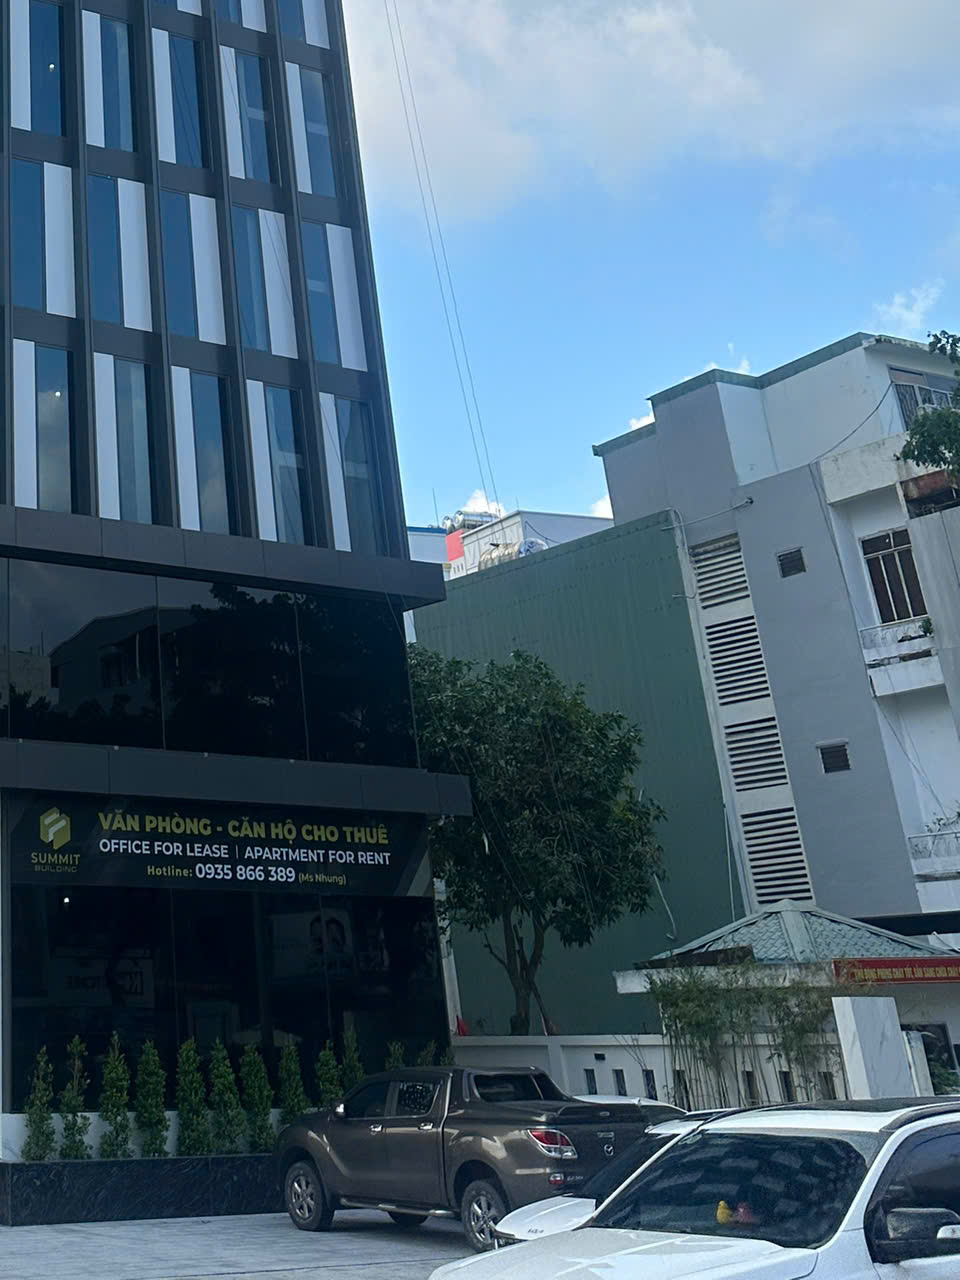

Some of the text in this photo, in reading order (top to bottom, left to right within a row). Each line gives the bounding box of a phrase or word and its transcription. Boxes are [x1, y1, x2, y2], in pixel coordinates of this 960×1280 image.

[98, 808, 140, 832] VĂN
[145, 812, 212, 836] PHÒNG
[228, 816, 266, 838] CĂN
[270, 819, 297, 844] HỘ
[301, 825, 339, 842] CHO
[343, 824, 389, 844] THUÊ
[31, 852, 81, 865] SUMMIT
[99, 838, 151, 854] OFFICE
[154, 841, 183, 855] FOR
[186, 843, 229, 858] LEASE
[244, 846, 326, 863] APARTMENT
[328, 850, 355, 864] FOR
[358, 852, 391, 865] RENT
[34, 865, 78, 873] BUILDING
[147, 865, 193, 877] Hotline:
[195, 863, 233, 880] 0935
[236, 865, 265, 881] 866
[268, 866, 296, 882] 389
[315, 874, 347, 885] Nhung)
